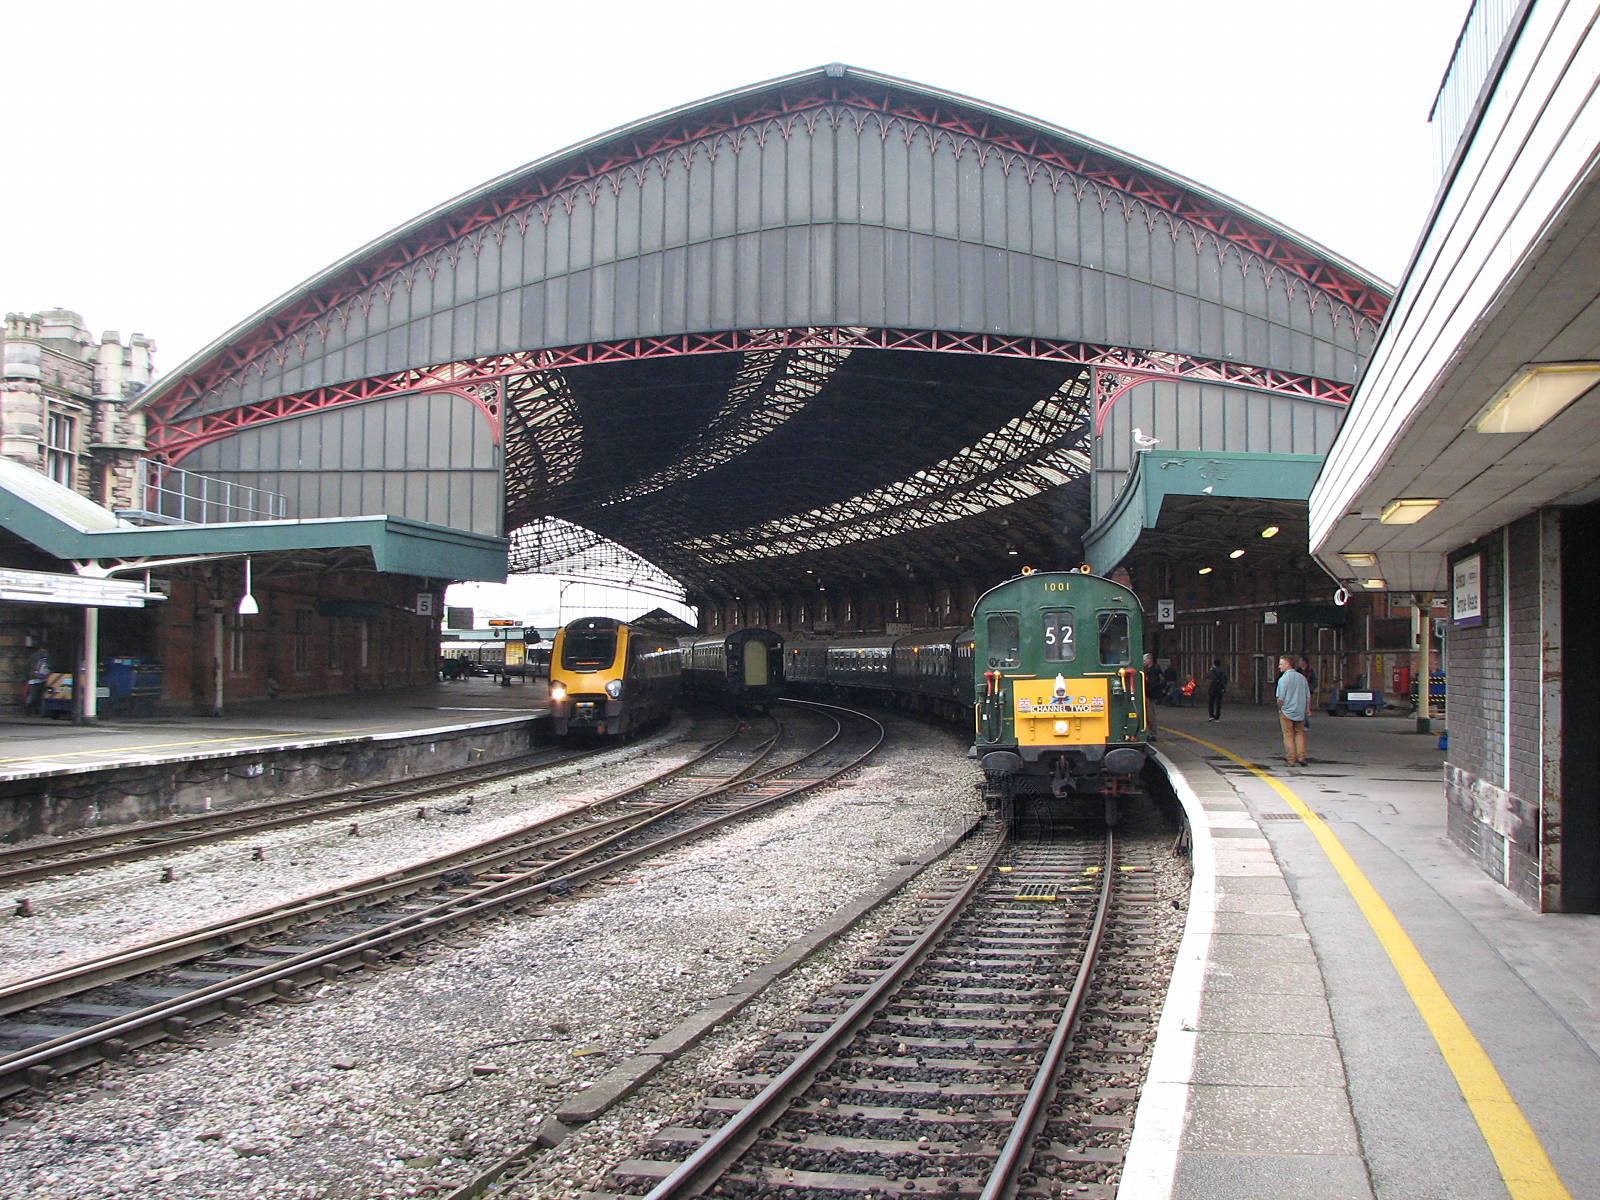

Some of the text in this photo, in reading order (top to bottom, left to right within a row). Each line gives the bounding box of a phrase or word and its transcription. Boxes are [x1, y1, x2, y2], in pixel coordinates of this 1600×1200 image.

[1044, 582, 1070, 591] 1001
[421, 600, 429, 611] 5
[1162, 607, 1170, 618] 3
[1031, 705, 1091, 713] CHANNEL TWO
